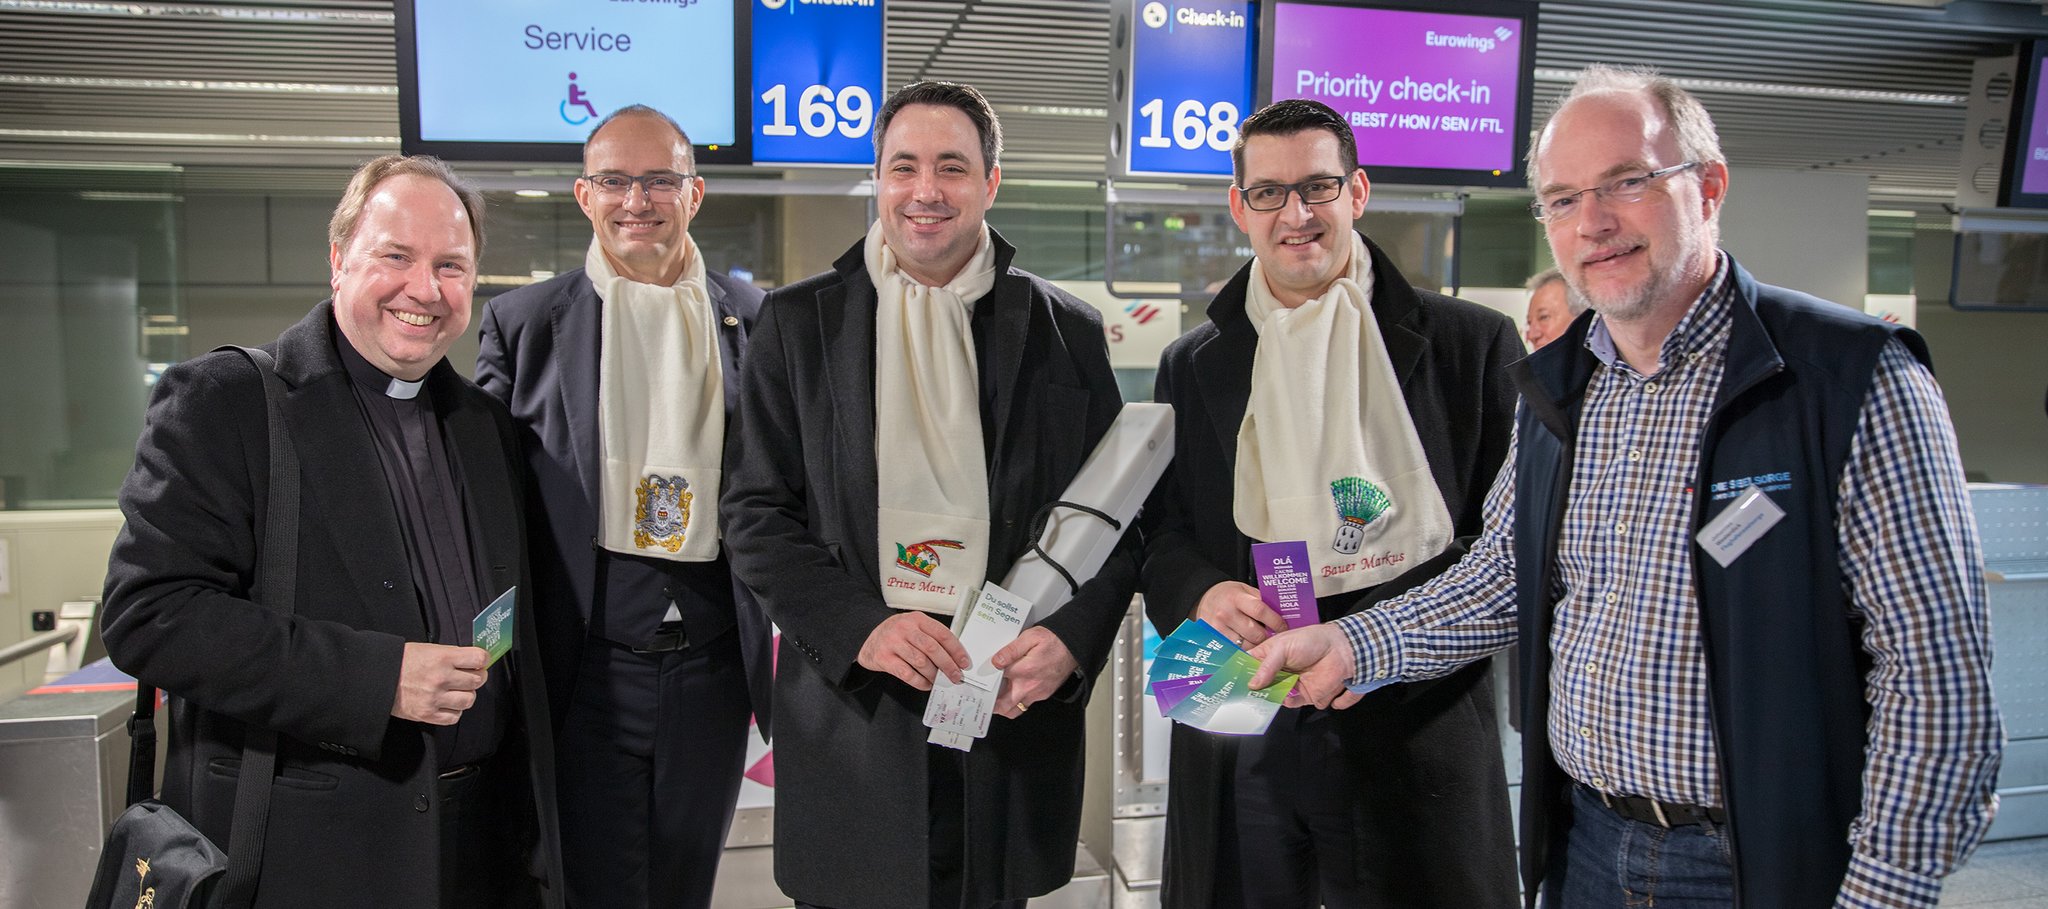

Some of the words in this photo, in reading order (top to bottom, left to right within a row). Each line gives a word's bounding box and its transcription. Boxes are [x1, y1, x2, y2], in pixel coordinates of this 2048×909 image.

[1176, 7, 1245, 28] Check-in
[524, 24, 631, 52] Service
[1425, 30, 1496, 53] Eurowings
[1296, 69, 1383, 105] Priority
[1388, 75, 1491, 105] check-in
[761, 84, 874, 139] 169
[1351, 111, 1389, 128] BEST
[1399, 114, 1431, 130] HON
[1441, 115, 1470, 132] SEN
[1479, 118, 1505, 134] FTL
[1139, 98, 1239, 152] 168
[1711, 482, 1728, 492] DIE
[1273, 556, 1293, 565] OLÁ
[1321, 563, 1356, 578] Bauer
[1360, 551, 1405, 570] Markus
[887, 577, 916, 590] Prinz
[918, 581, 946, 594] Marc
[948, 585, 956, 596] I.
[1262, 572, 1308, 580] WILLKOMMEN
[1263, 577, 1309, 586] WELCOME
[981, 602, 994, 612] ein
[994, 607, 1021, 625] Segen
[985, 592, 997, 604] Du
[996, 600, 1019, 614] sollst
[976, 610, 997, 625] sein.
